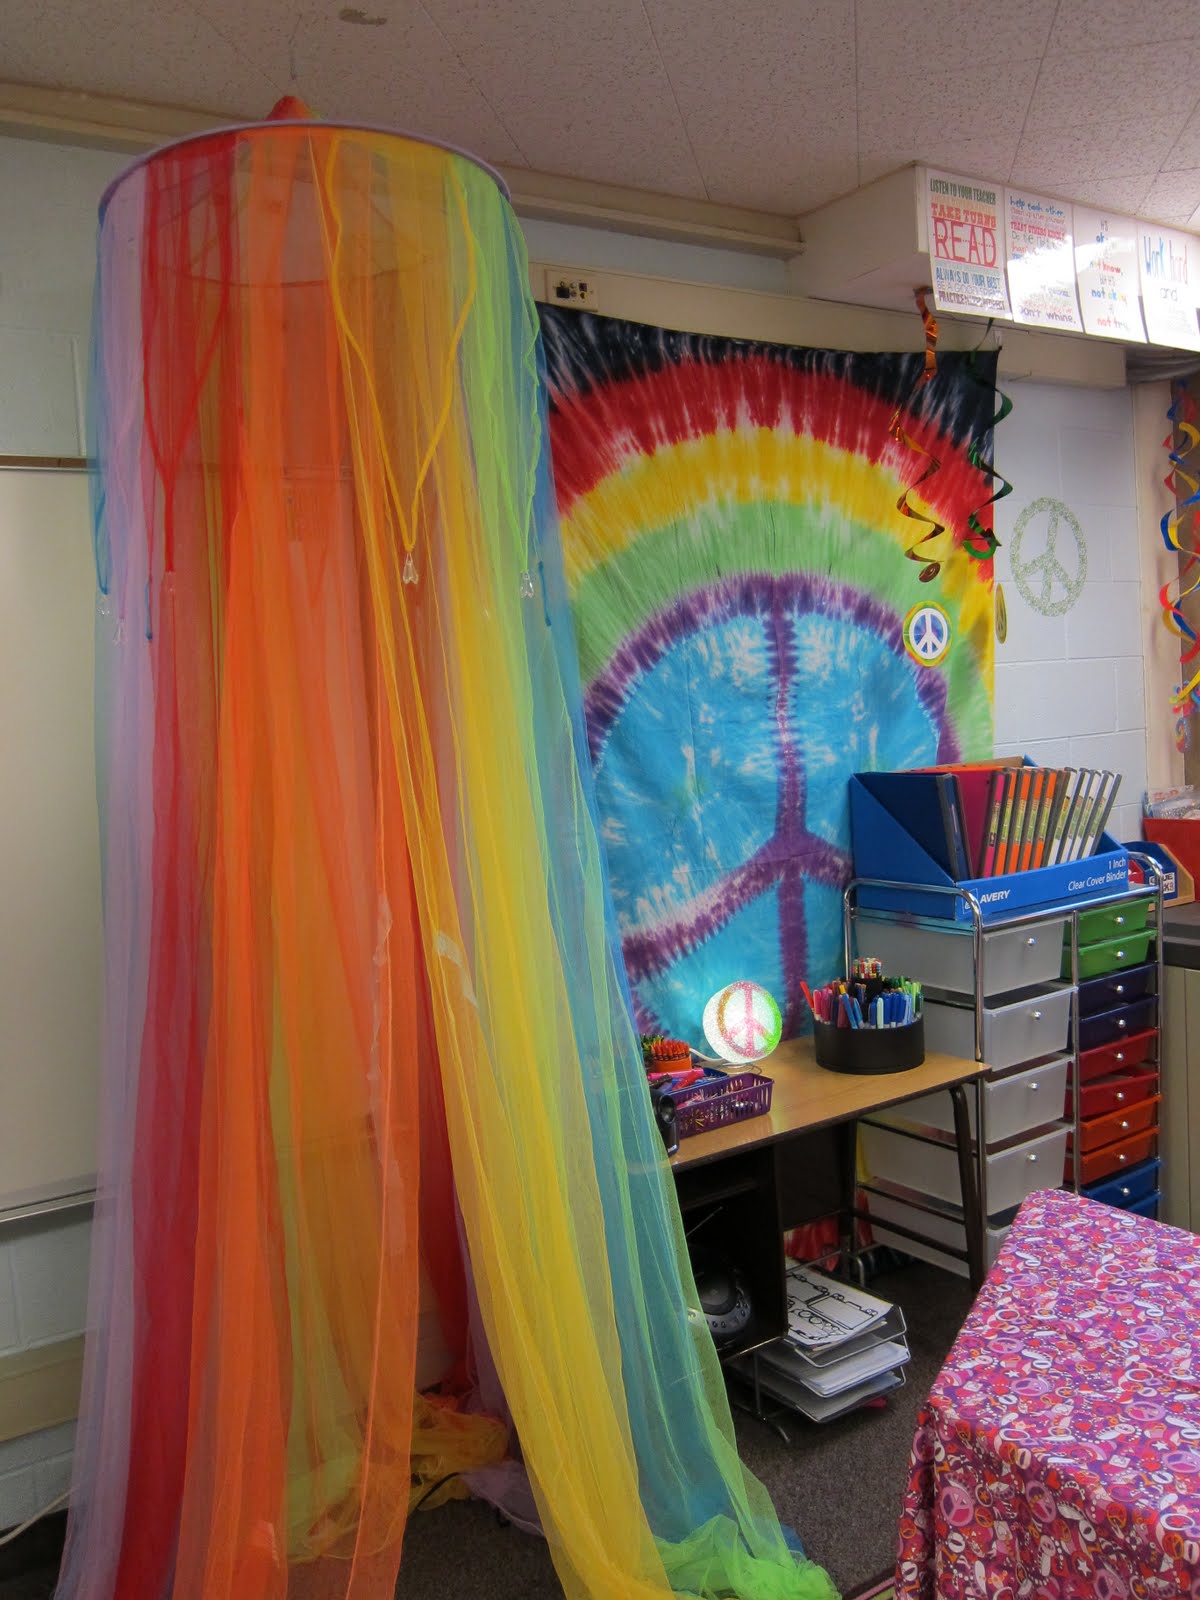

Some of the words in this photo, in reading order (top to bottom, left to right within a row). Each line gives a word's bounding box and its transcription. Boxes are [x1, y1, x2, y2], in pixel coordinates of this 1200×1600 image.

[930, 178, 949, 195] LISTEN
[950, 182, 958, 197] TO
[958, 184, 973, 200] YOUR
[973, 188, 997, 205] TEACHER
[931, 202, 962, 221] TAKE
[963, 209, 997, 229] TURNS
[932, 217, 997, 268] READ
[936, 266, 961, 283] ALWAYS
[962, 271, 970, 285] DO
[971, 273, 986, 288] YOUR
[986, 276, 1001, 290] BEST
[1091, 286, 1106, 300] not
[1096, 316, 1112, 328] not
[1108, 860, 1112, 870] 1
[1113, 857, 1127, 868] Inch
[1068, 880, 1086, 892] Clear
[1086, 875, 1106, 887] Cover
[1106, 869, 1127, 882] Binder
[980, 889, 1010, 904] AVERY
